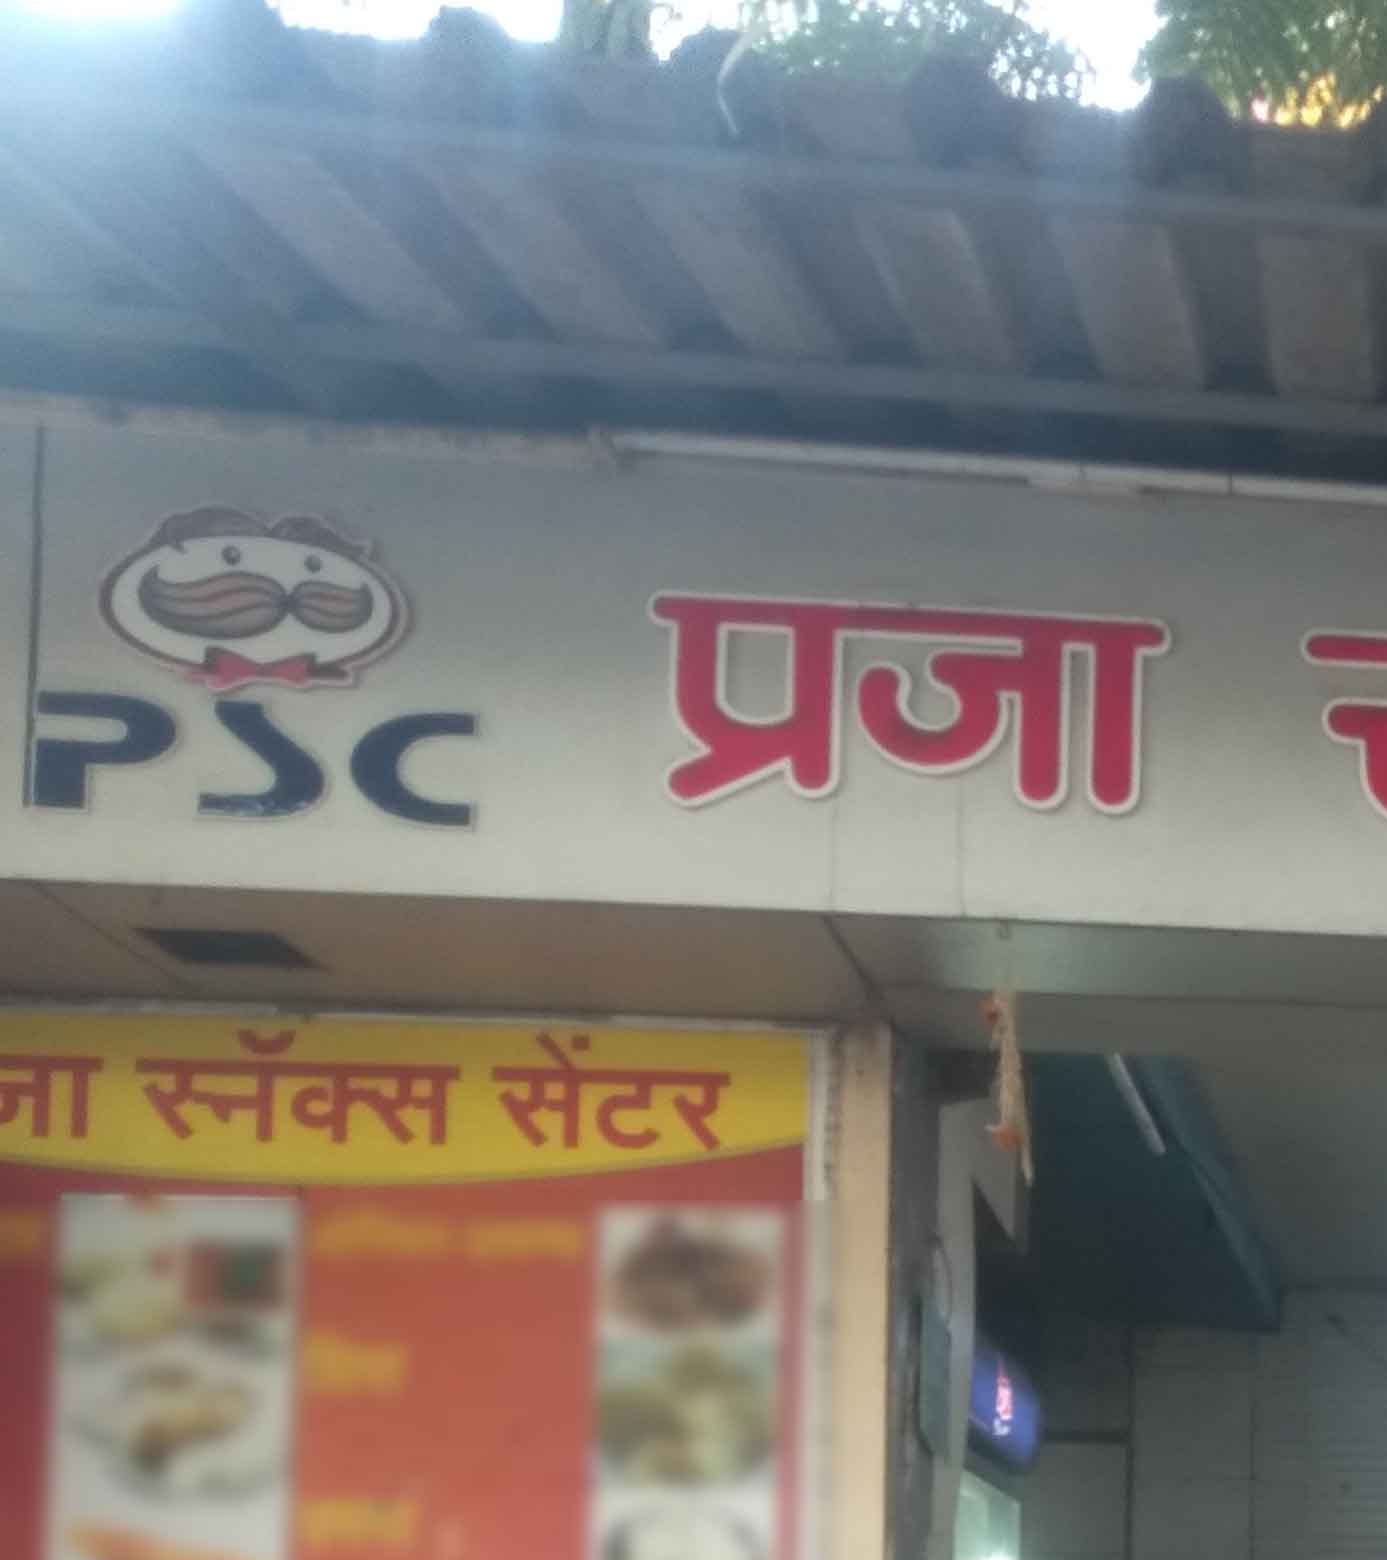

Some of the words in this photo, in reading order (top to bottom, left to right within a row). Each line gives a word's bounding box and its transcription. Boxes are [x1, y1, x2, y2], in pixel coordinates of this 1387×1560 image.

[34, 688, 477, 828] PSC
[650, 592, 1172, 814] प्रजा
[0, 1055, 104, 1139] जा
[135, 1029, 461, 1146] स्नॅक्स
[491, 1032, 731, 1150] सेंटर
